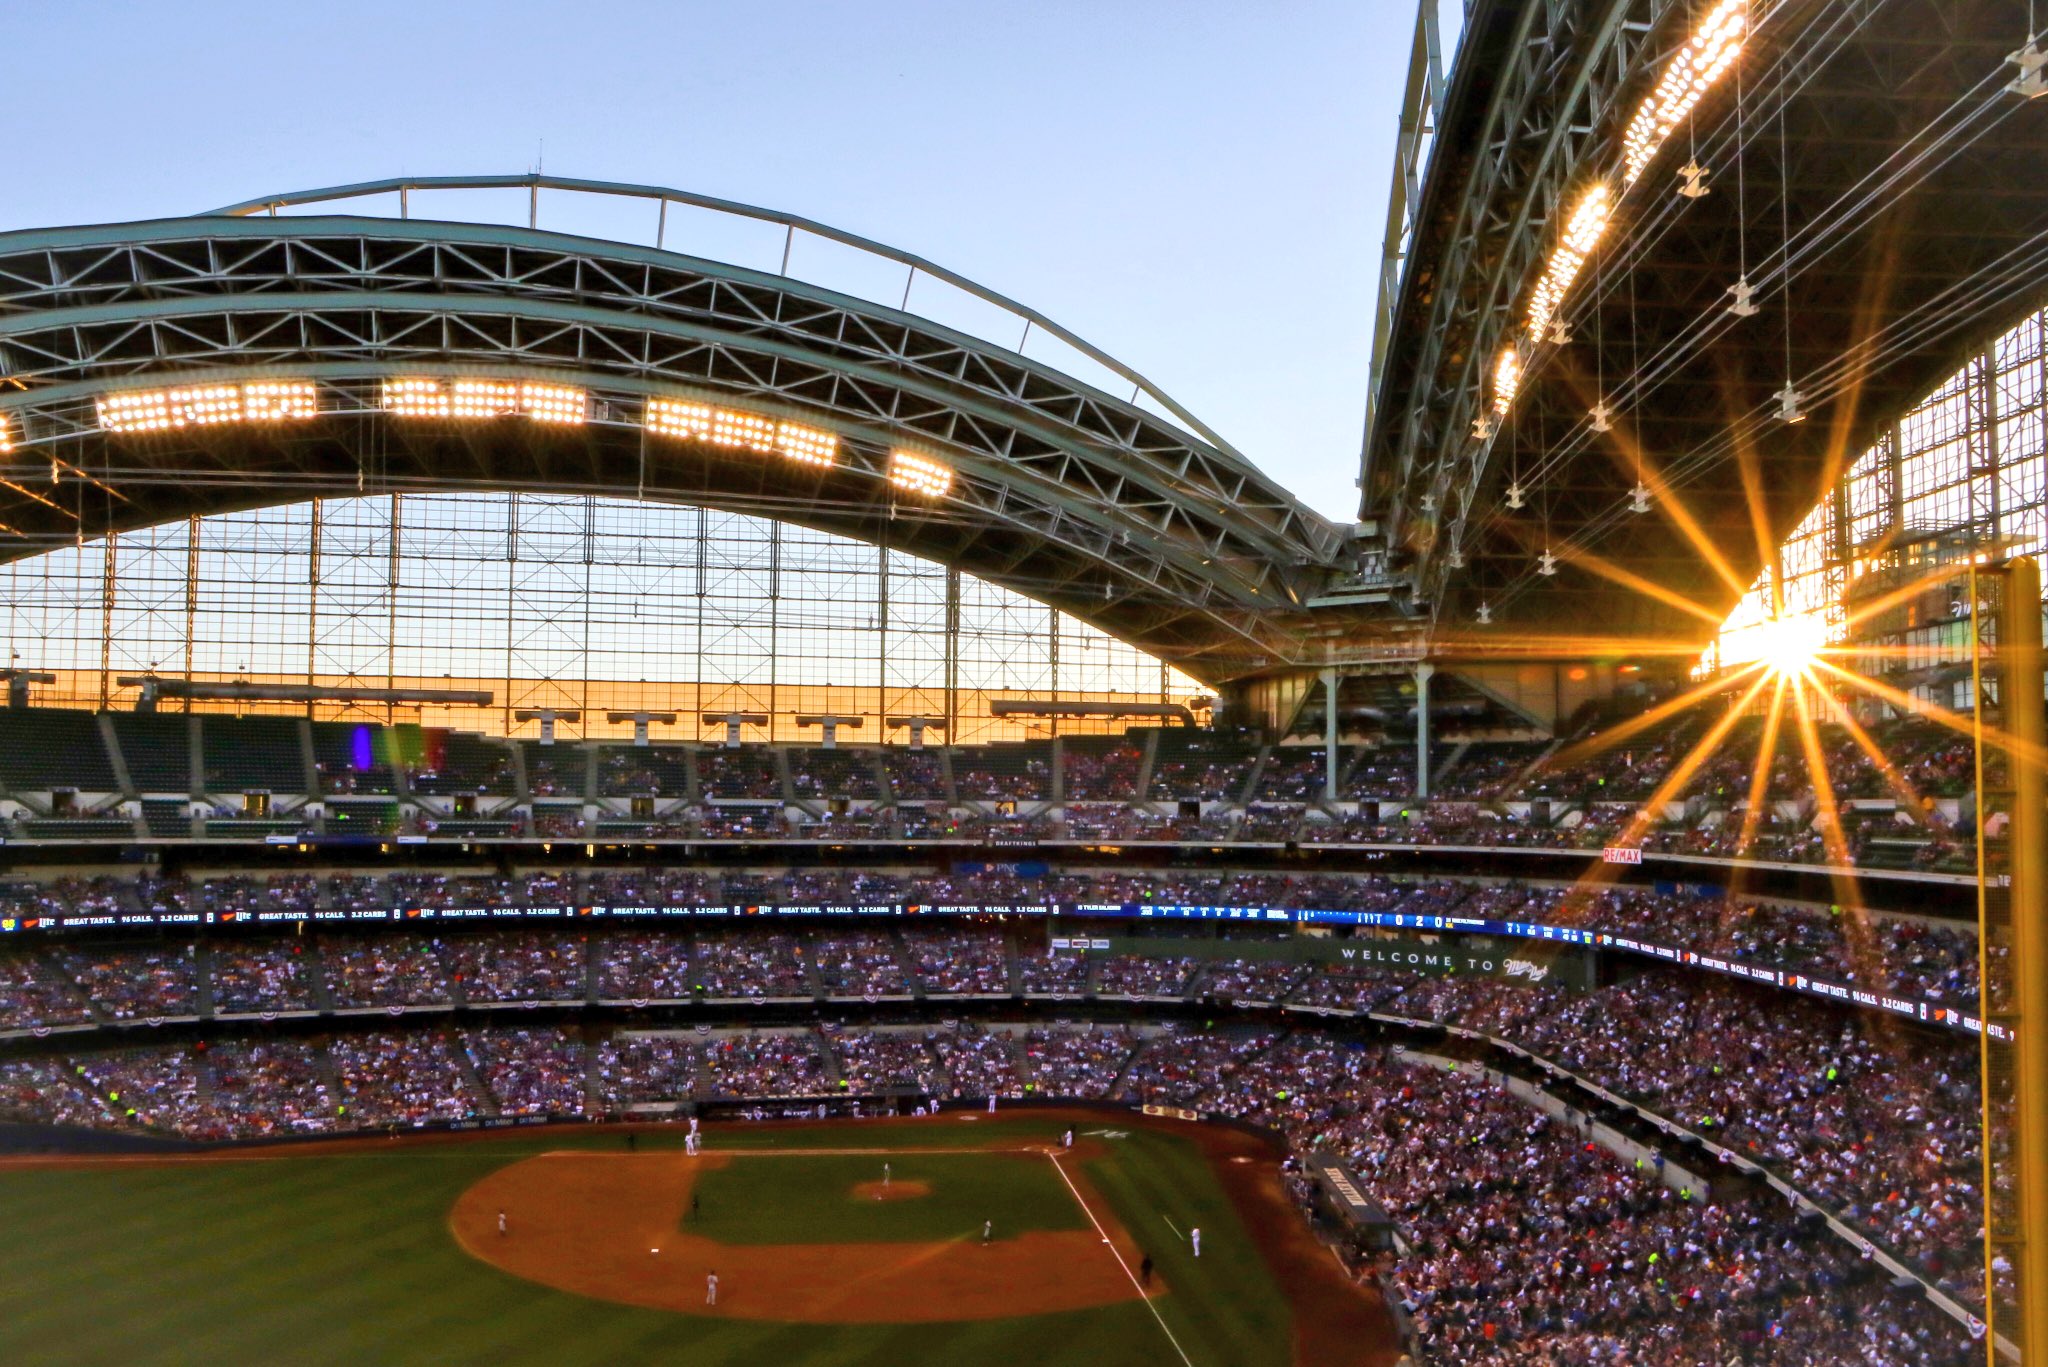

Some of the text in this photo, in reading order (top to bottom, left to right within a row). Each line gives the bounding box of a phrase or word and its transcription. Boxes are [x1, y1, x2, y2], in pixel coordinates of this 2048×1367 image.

[1604, 848, 1640, 863] RE/MAX
[996, 863, 1019, 873] PNC
[421, 909, 435, 918] Lite
[591, 906, 606, 916] Lite
[759, 905, 773, 914] Lite
[919, 905, 932, 914] Lite
[38, 918, 56, 928] Lite
[63, 918, 89, 926] GREAT
[90, 917, 116, 925] TASTE.
[173, 914, 199, 922] CARBS
[235, 912, 252, 922] Lite
[1395, 915, 1402, 926] 0
[1416, 915, 1423, 927] 2
[1434, 916, 1442, 928] 0
[1342, 949, 1549, 982] WELCOME TO Miller Park
[1759, 970, 1774, 982] CARBS
[1812, 982, 1829, 993] GREAT
[1829, 985, 1848, 999] TASTE.
[1852, 990, 1860, 1000] 96
[1860, 992, 1877, 1006] CALS.
[1882, 997, 1893, 1009] 3.2
[1892, 1000, 1914, 1014] CARBS
[1987, 1023, 2005, 1039] ASTE.
